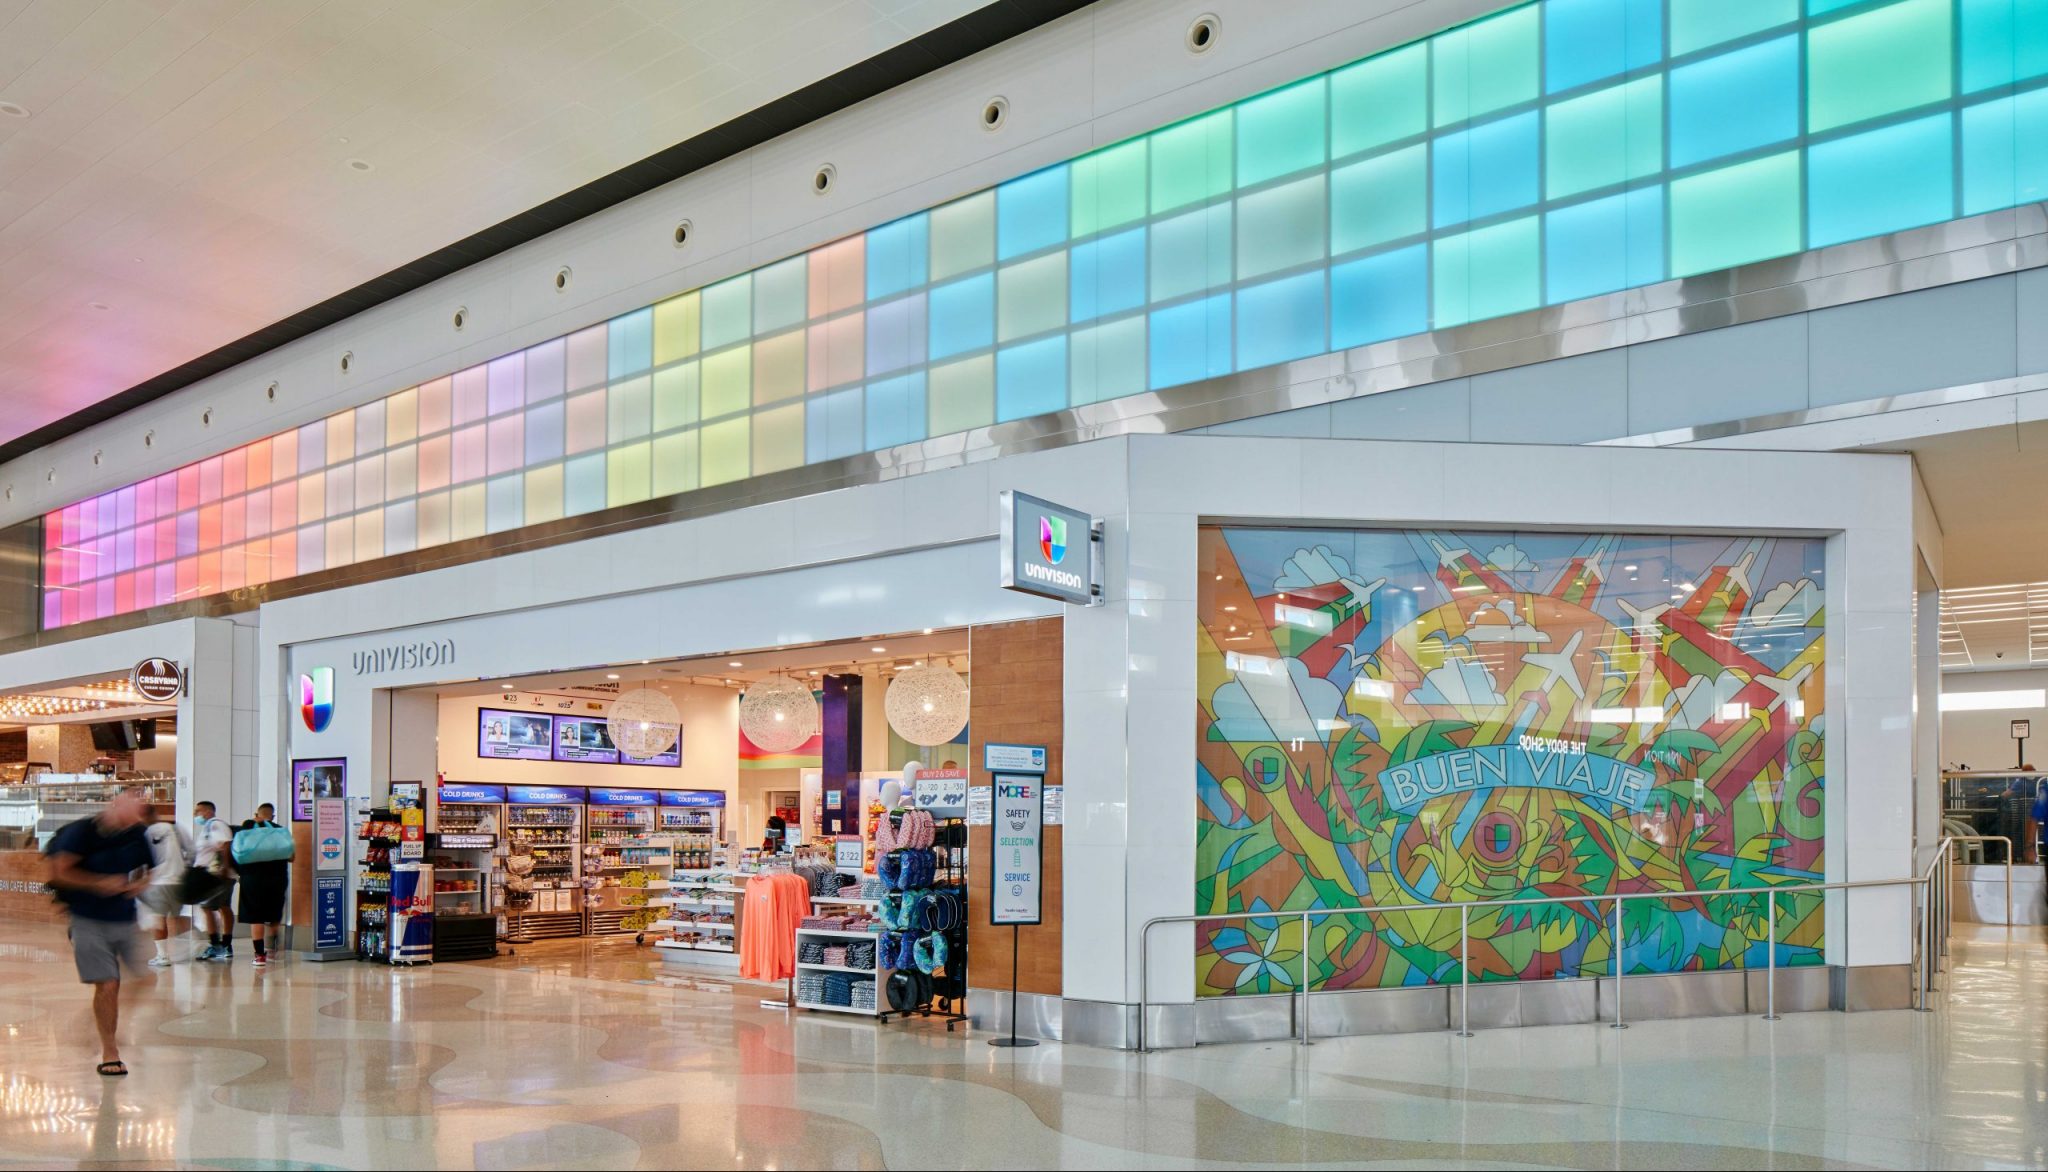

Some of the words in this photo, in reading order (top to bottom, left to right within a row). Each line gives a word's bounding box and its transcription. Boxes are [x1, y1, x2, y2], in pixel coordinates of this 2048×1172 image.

[1025, 562, 1081, 588] UNIVISION
[353, 639, 455, 675] UNIVISION
[1390, 748, 1508, 805] BUEN
[1521, 749, 1646, 806] VIAJE
[999, 785, 1030, 799] MORE
[1005, 809, 1031, 819] SAFETY
[999, 837, 1034, 847] SELECTION
[1004, 873, 1032, 882] SERVICE
[412, 895, 432, 907] Bull
